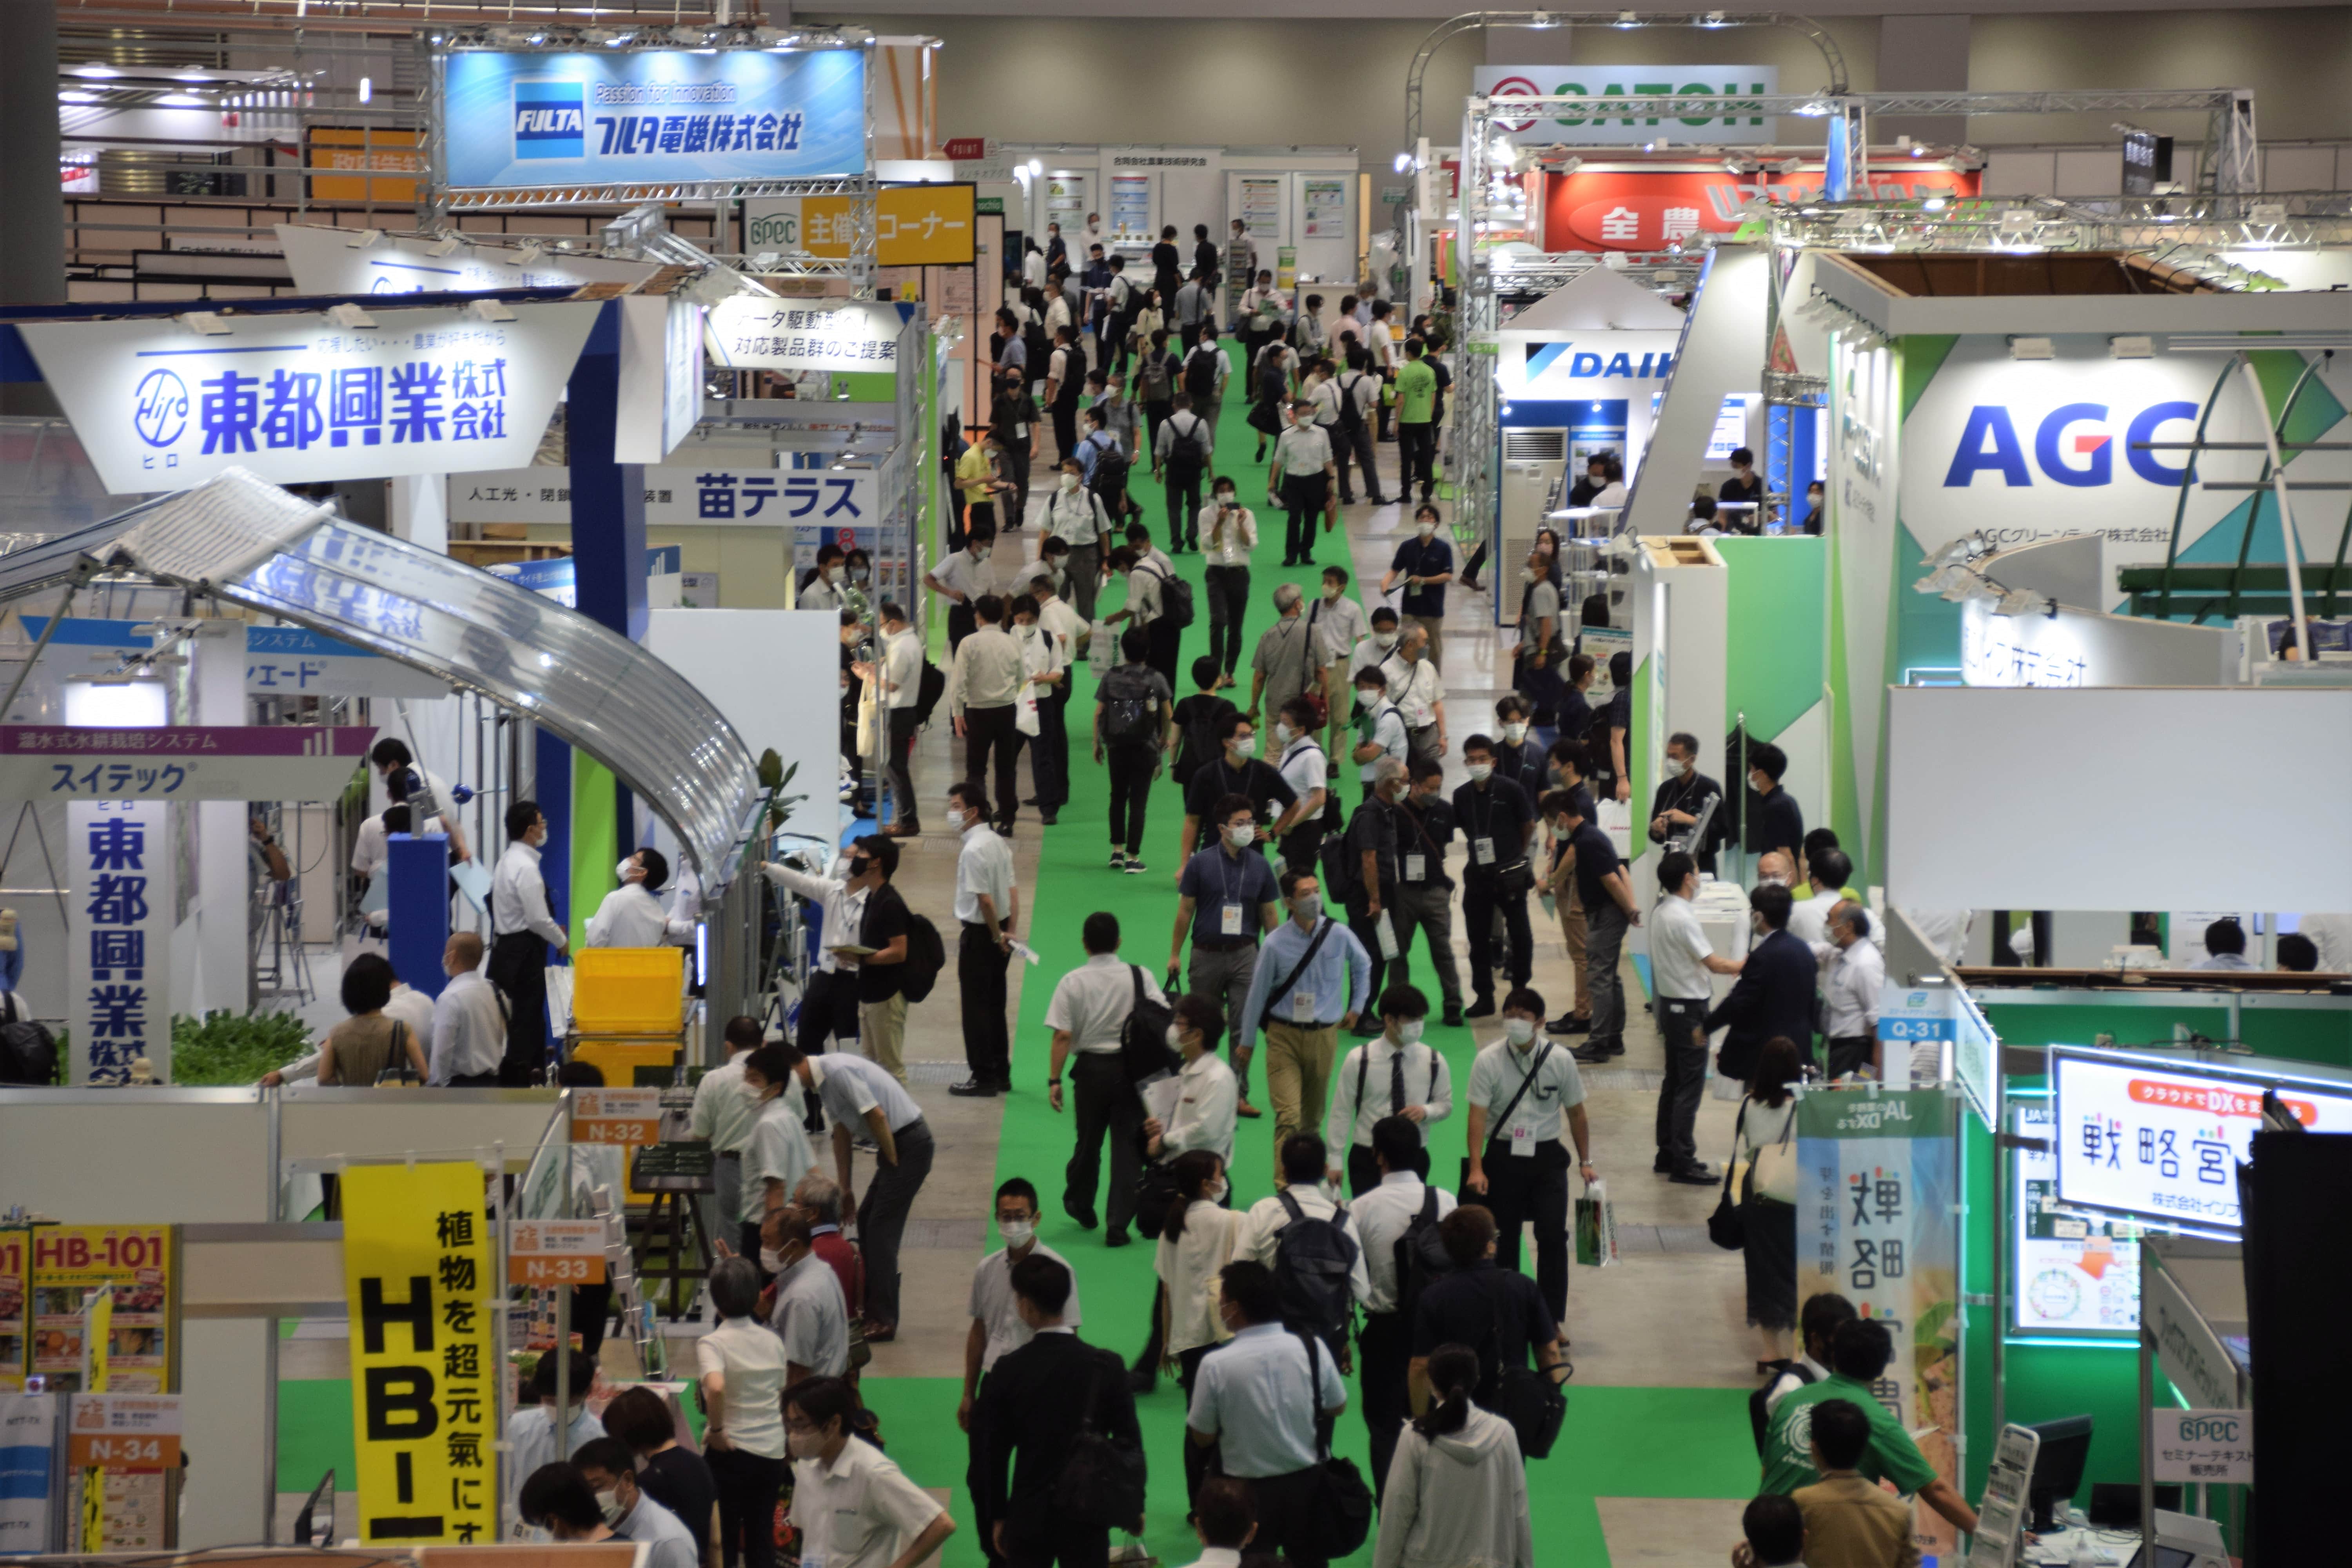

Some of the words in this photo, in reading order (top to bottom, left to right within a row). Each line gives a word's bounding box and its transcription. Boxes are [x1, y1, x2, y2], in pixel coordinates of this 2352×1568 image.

[595, 82, 644, 104] Passion
[647, 82, 668, 103] for
[670, 81, 735, 103] Innovation
[1553, 83, 1764, 126] SATOH
[516, 109, 583, 132] FULTA
[595, 112, 802, 154] フルタ電機株式会社
[808, 210, 965, 245] 主催コーナー
[1601, 206, 1699, 241] 全農
[735, 336, 897, 360] 対応製品群のご提案
[1942, 401, 2200, 487] AGC
[696, 473, 862, 518] 苗テラス
[51, 763, 186, 793] スイテック
[1892, 1021, 1940, 1037] Q-31
[2143, 1085, 2303, 1120] クラウドでDXを支る
[589, 1123, 643, 1140] N-32
[35, 1236, 163, 1269] HB-101
[527, 1259, 588, 1279] N-33
[89, 1439, 160, 1461] N-34
